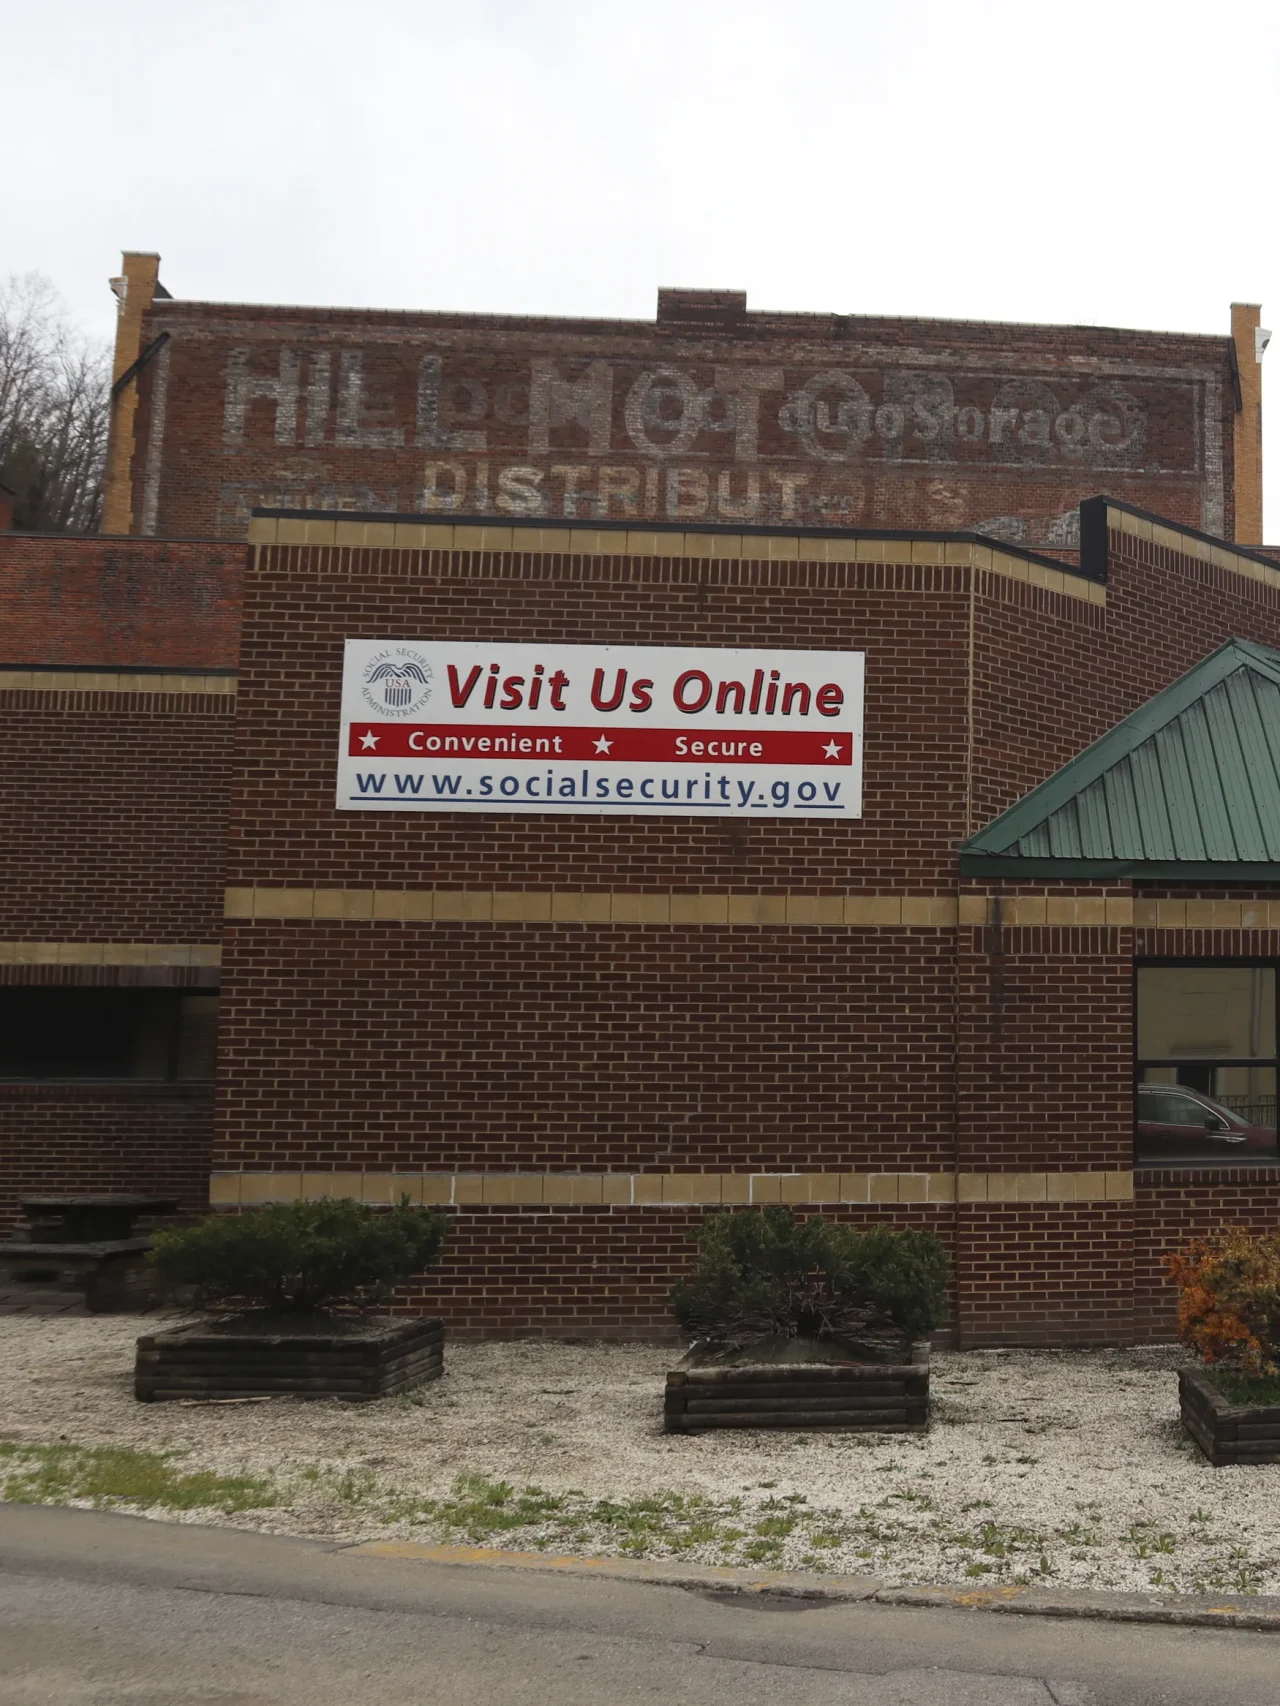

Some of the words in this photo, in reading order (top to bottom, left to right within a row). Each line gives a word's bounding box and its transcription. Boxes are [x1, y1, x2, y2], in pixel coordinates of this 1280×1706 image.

[362, 649, 392, 678] SOCIAL
[395, 647, 434, 680] SECURITY
[385, 678, 410, 688] USA
[446, 664, 569, 710] Visit
[590, 667, 653, 712] Us
[673, 669, 844, 717] Online
[361, 686, 433, 718] ADMINISTRATION
[408, 731, 563, 754] Convenient
[675, 736, 763, 757] Secure
[356, 769, 842, 809] www.socialsecurity.gov
